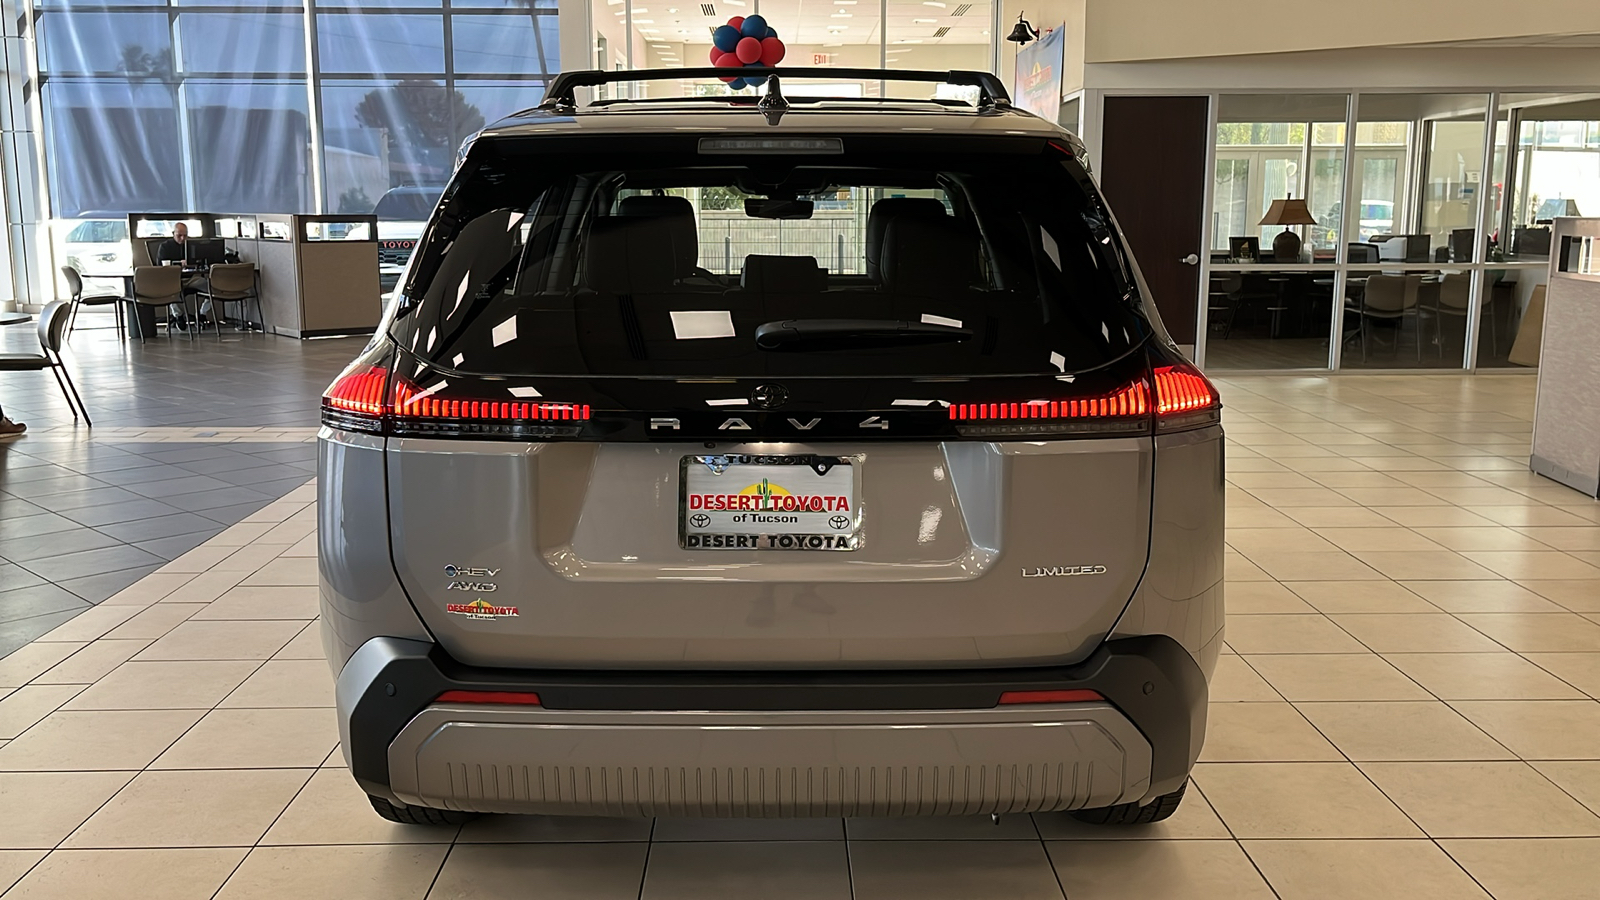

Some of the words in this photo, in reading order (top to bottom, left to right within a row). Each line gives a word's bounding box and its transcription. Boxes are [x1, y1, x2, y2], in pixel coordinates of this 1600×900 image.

[814, 54, 827, 65] EXIT
[382, 241, 416, 249] TOYOT
[725, 455, 811, 465] TUCSON
[689, 494, 764, 510] DESERT
[770, 495, 850, 512] TOYOTA
[733, 513, 747, 523] of
[750, 513, 798, 524] Tucson
[688, 535, 760, 548] DESERT
[768, 535, 849, 549] TOYOTA
[1021, 565, 1107, 577] LIMITED
[447, 581, 498, 592] AWD
[447, 604, 479, 614] DESERT
[482, 606, 519, 616] TOYOTA
